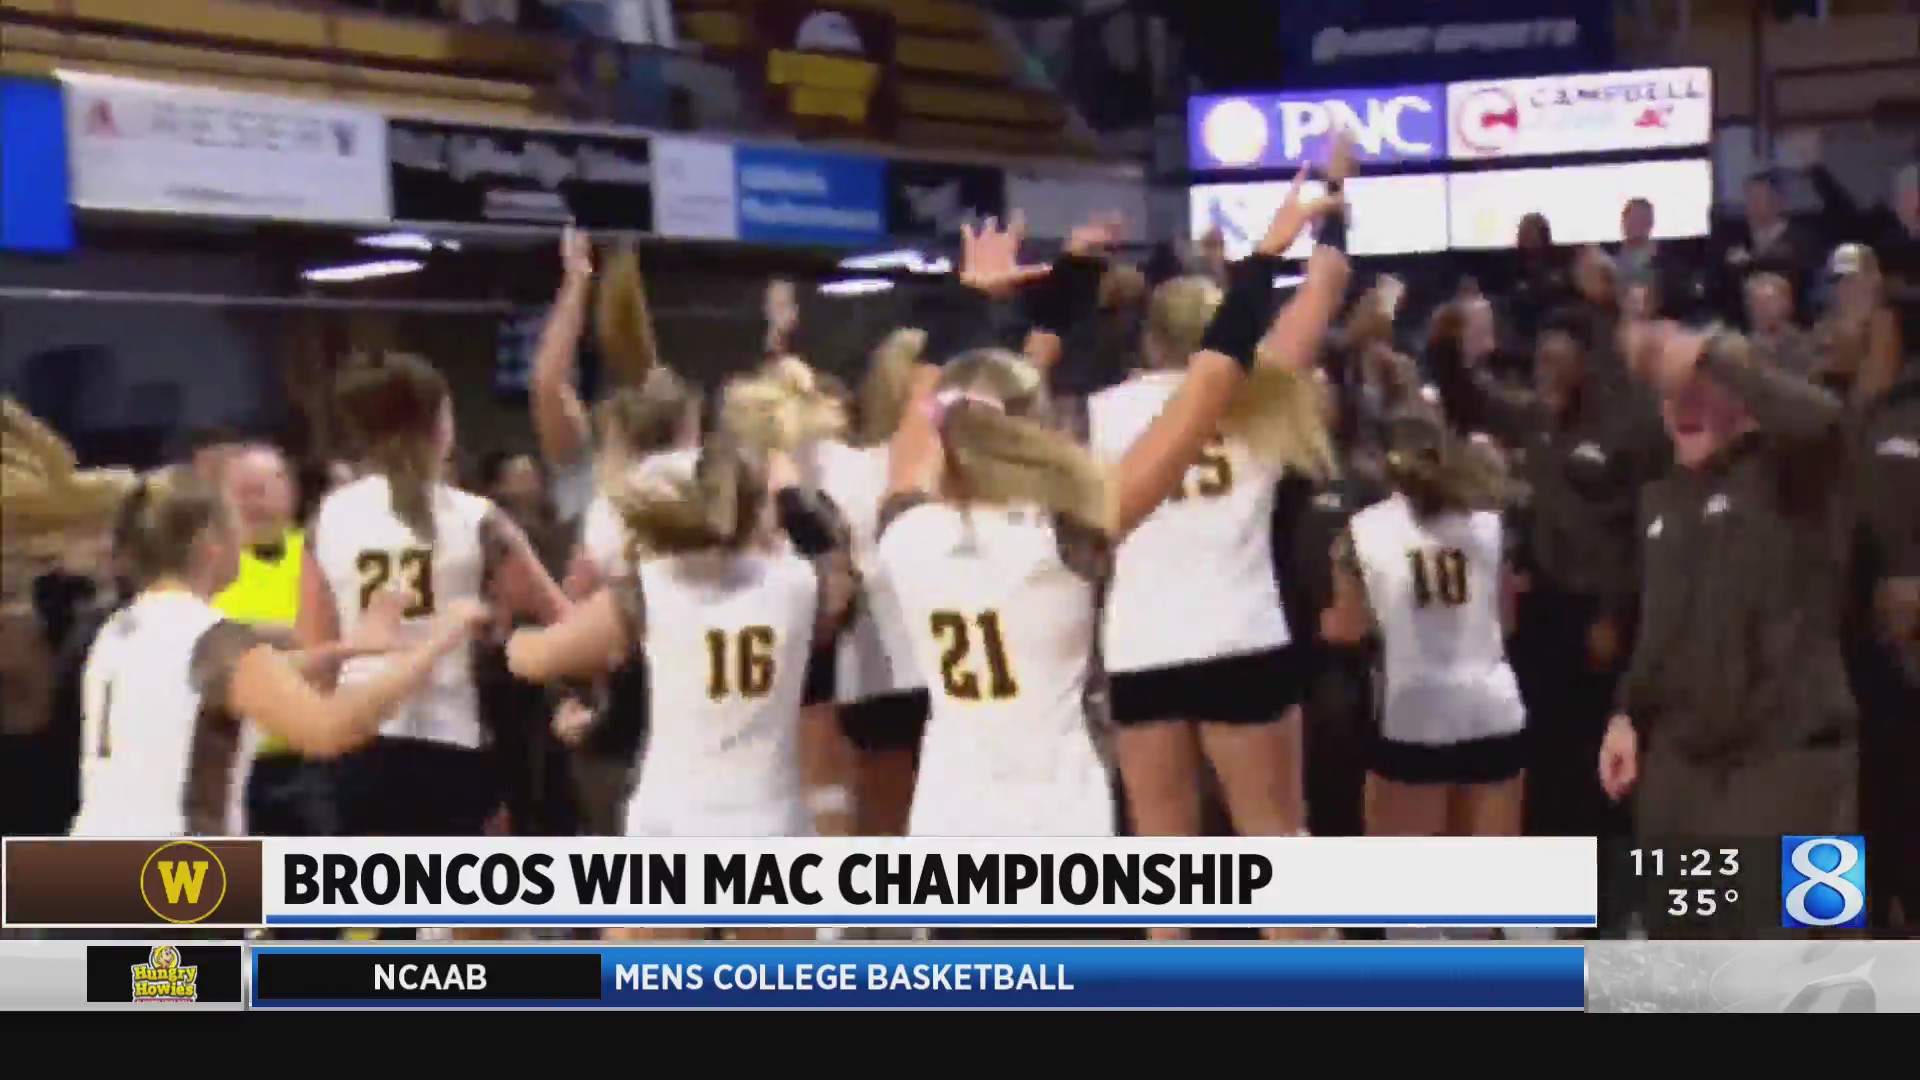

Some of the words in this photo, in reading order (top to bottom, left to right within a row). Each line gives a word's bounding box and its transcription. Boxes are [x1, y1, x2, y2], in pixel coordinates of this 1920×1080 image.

[1279, 95, 1433, 160] PNC
[356, 549, 437, 619] 23
[704, 624, 777, 700] 16
[930, 609, 1020, 701] 21
